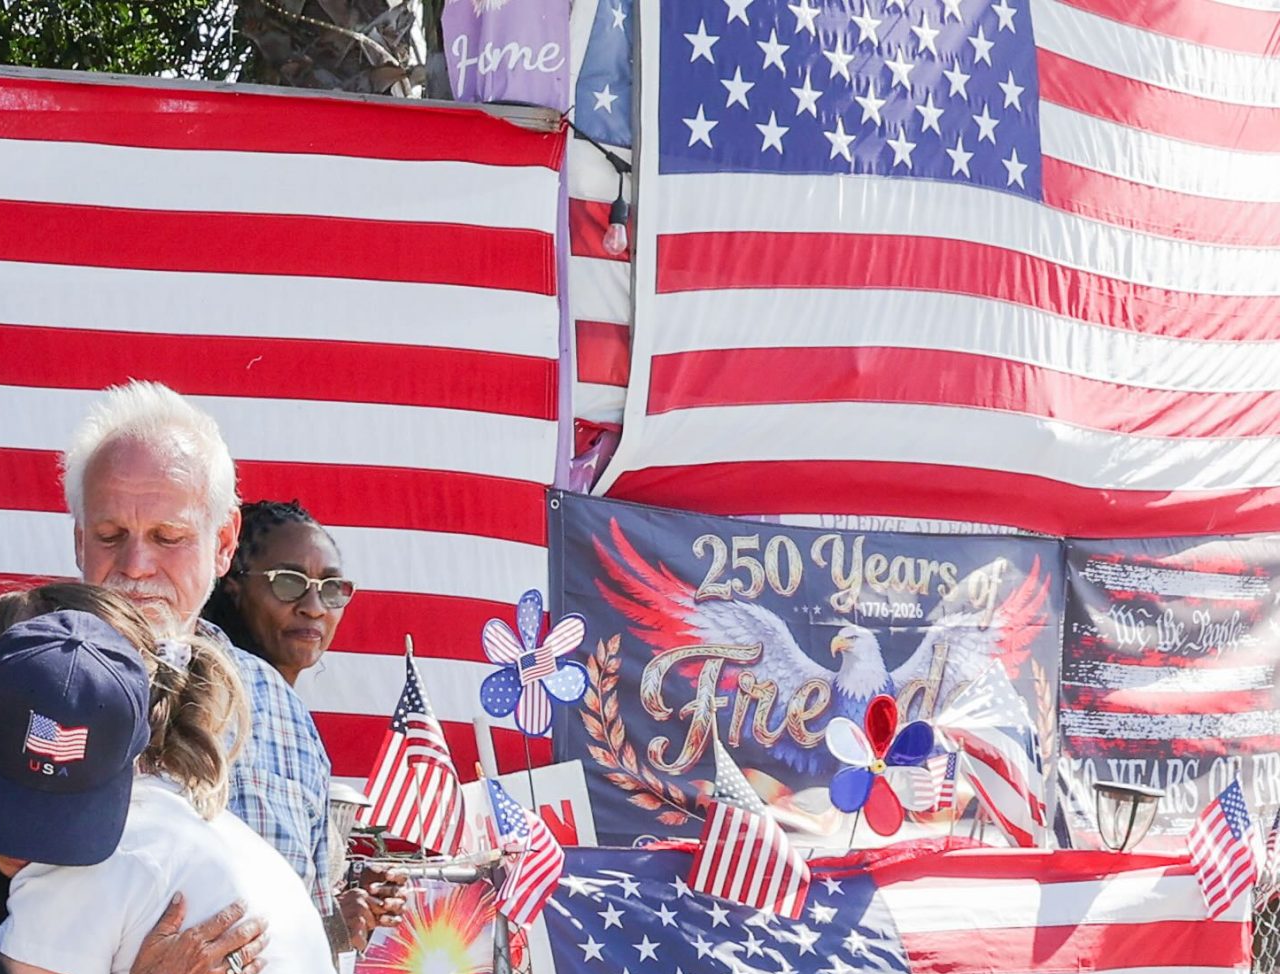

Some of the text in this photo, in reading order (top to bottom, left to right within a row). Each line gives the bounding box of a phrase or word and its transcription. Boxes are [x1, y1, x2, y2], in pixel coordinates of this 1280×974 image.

[692, 533, 1008, 631] 250 Years of
[860, 601, 924, 619] 1776-2026
[1106, 604, 1243, 660] We the People
[29, 759, 69, 777] USA
